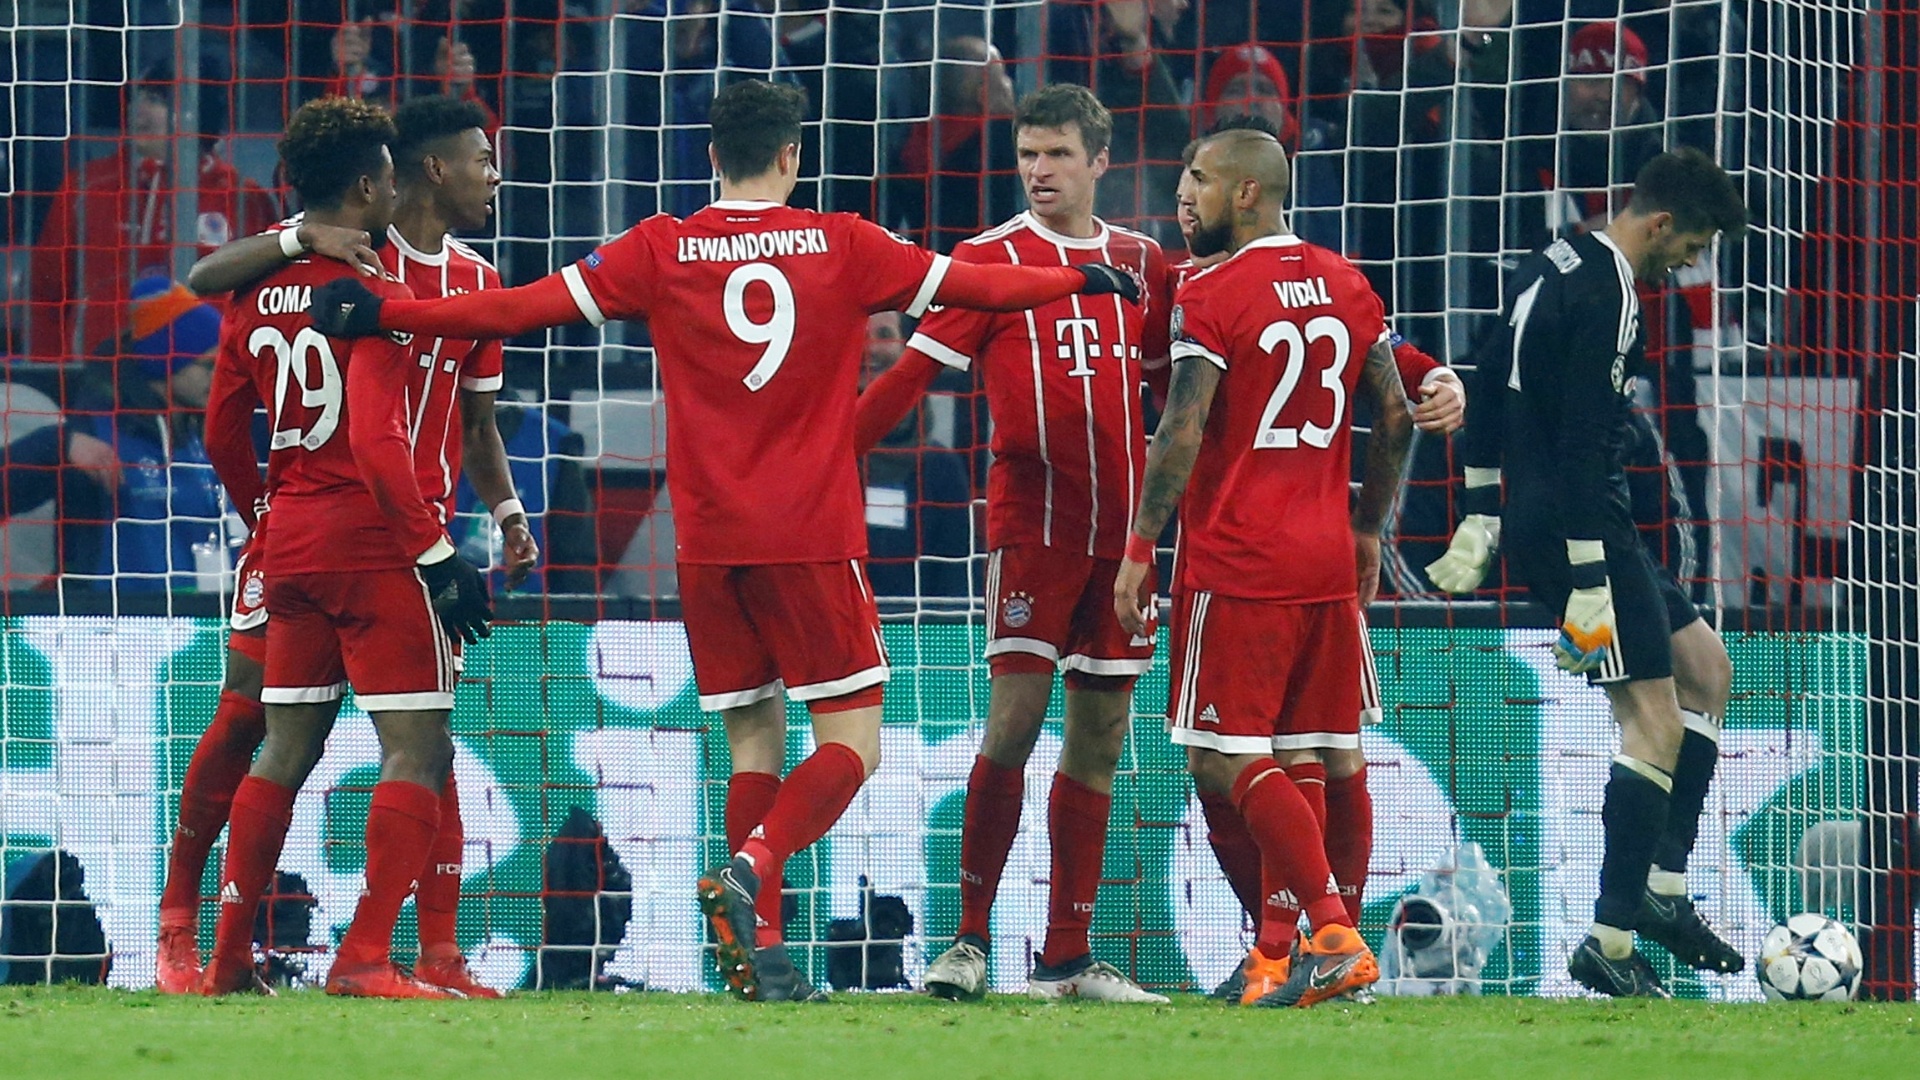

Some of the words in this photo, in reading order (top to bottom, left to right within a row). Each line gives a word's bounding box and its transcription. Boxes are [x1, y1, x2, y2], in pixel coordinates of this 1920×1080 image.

[677, 228, 828, 263] LEWANDOWSKI
[1272, 276, 1332, 309] VIDAL
[249, 327, 342, 451] 29
[724, 262, 796, 392] 9
[1258, 316, 1350, 450] 23
